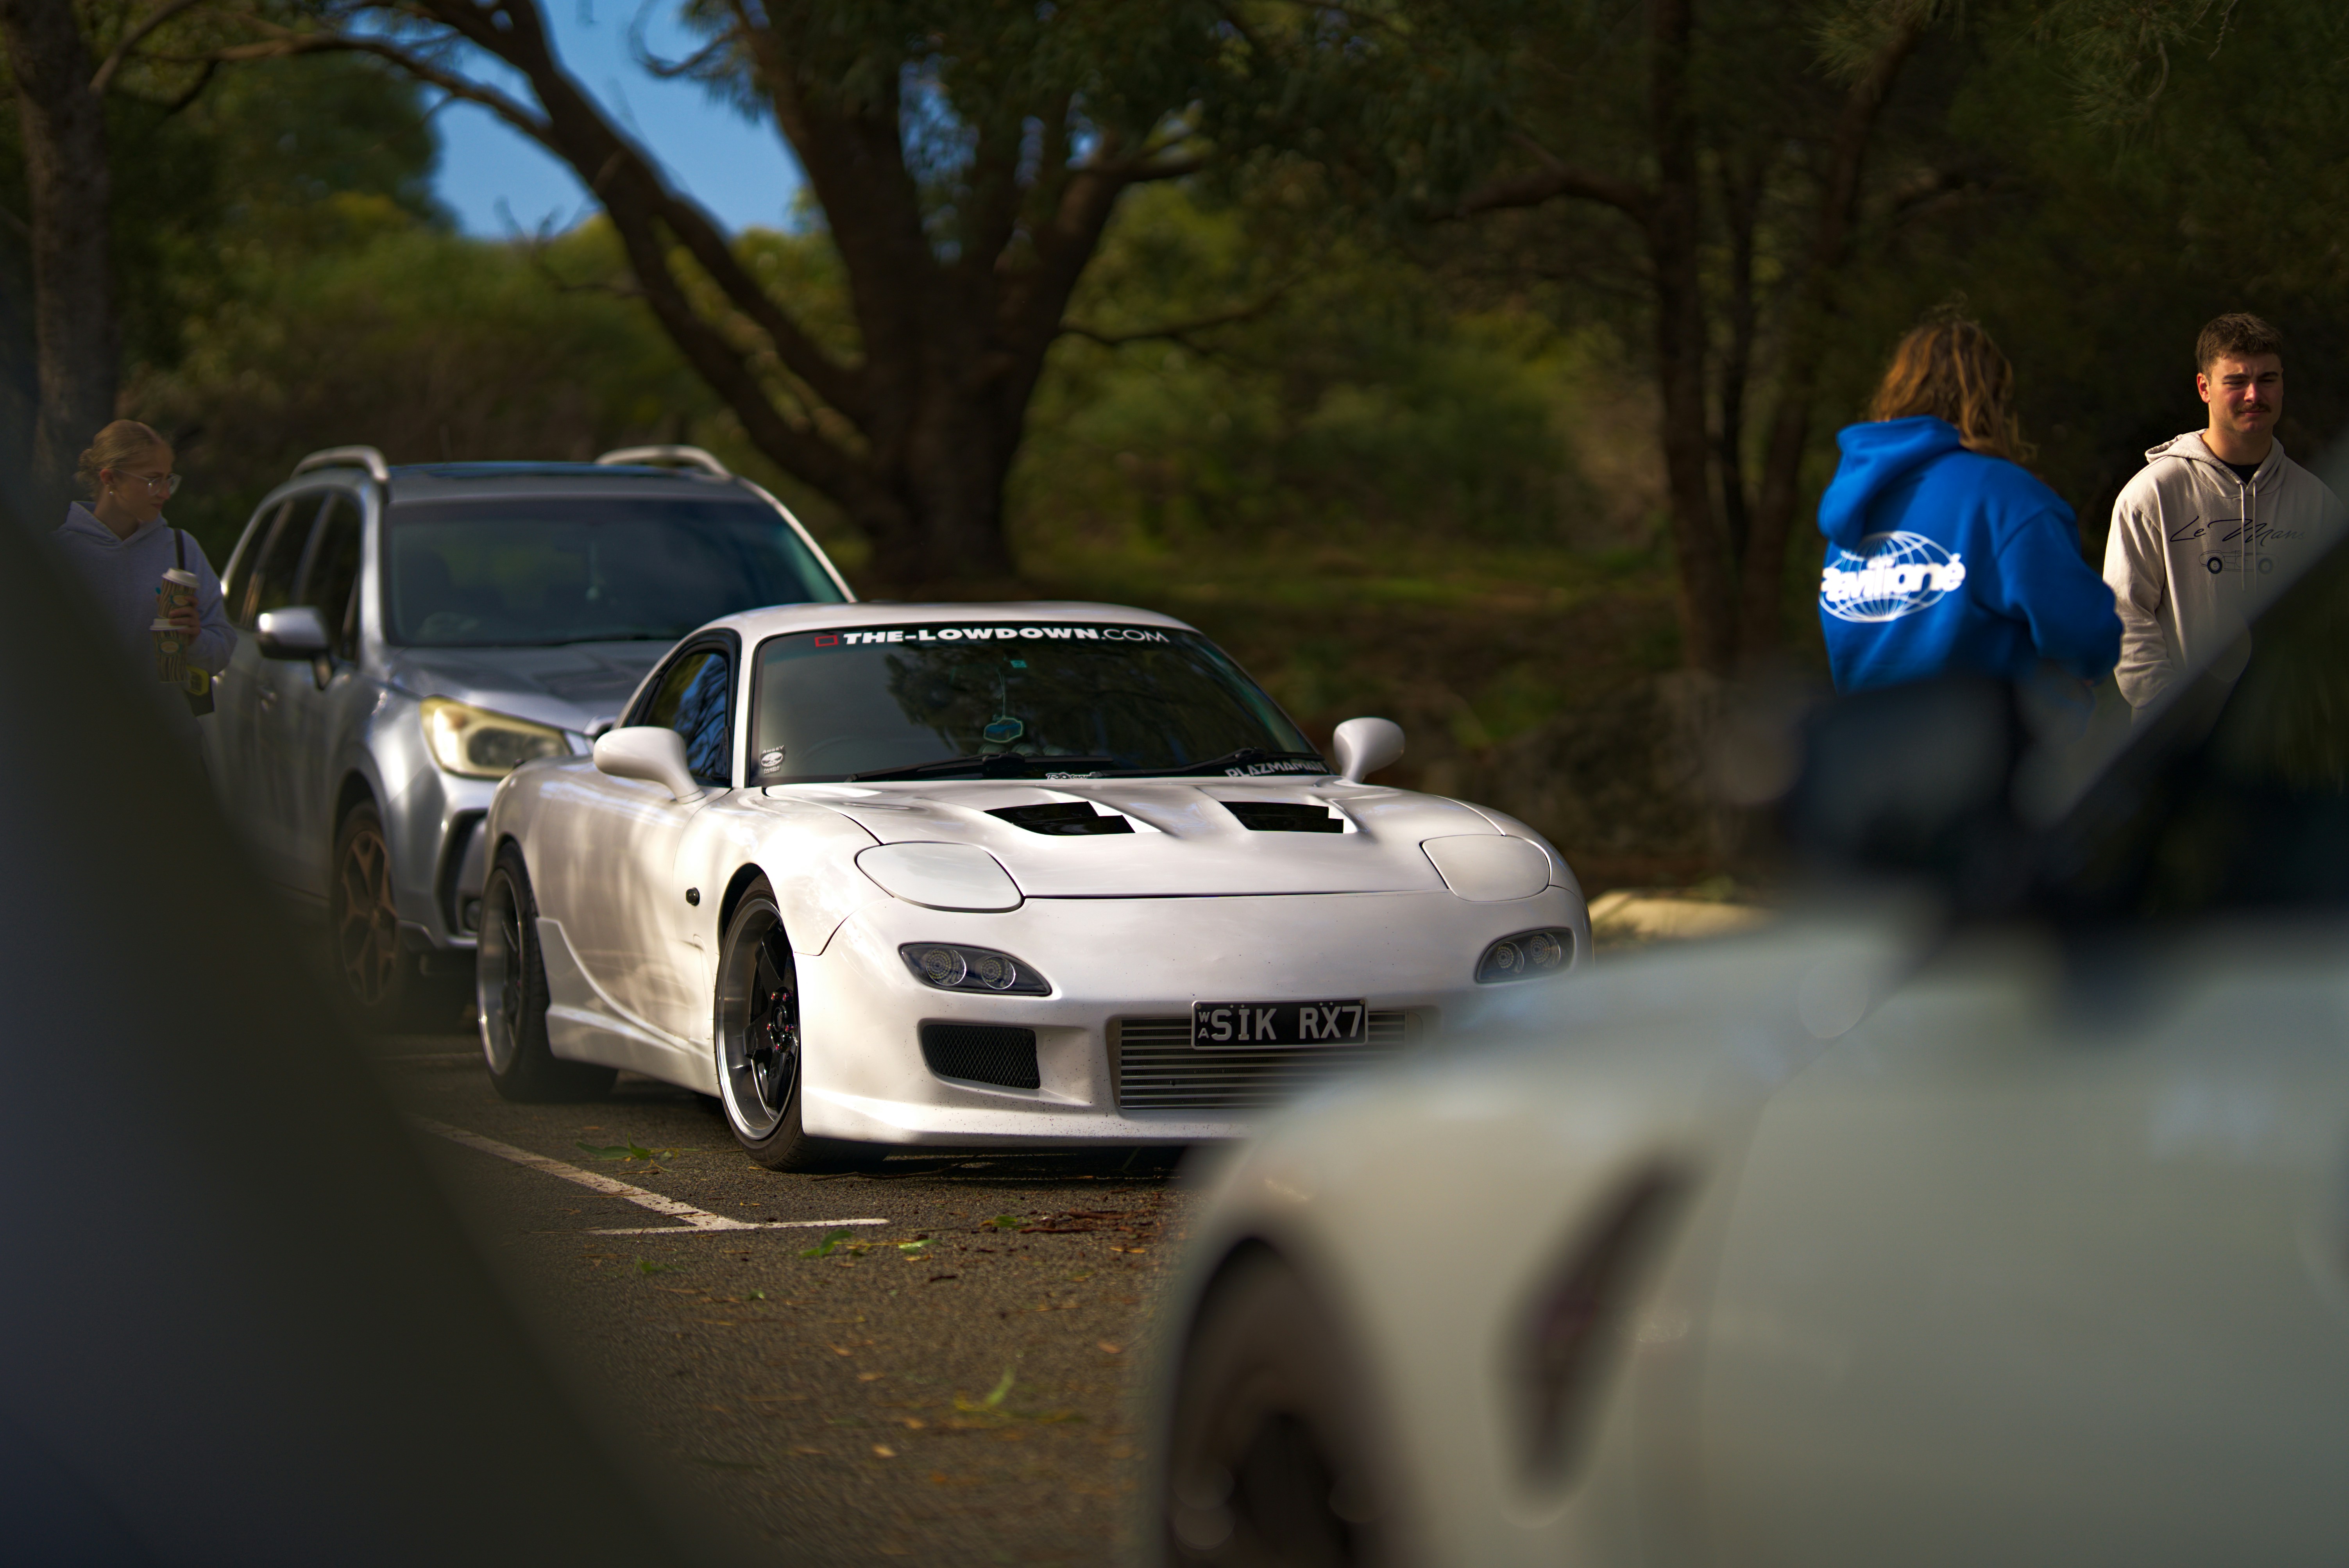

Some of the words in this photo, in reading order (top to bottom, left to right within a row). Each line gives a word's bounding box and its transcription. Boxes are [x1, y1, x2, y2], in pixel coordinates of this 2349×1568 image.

[2170, 515, 2206, 542] Le
[2208, 518, 2306, 547] Mans
[843, 628, 1170, 645] THE-LOWDOWN.COM
[1224, 760, 1327, 777] PLAZMAMAN
[1211, 1008, 1277, 1041] SIK
[1299, 1006, 1362, 1039] RX7
